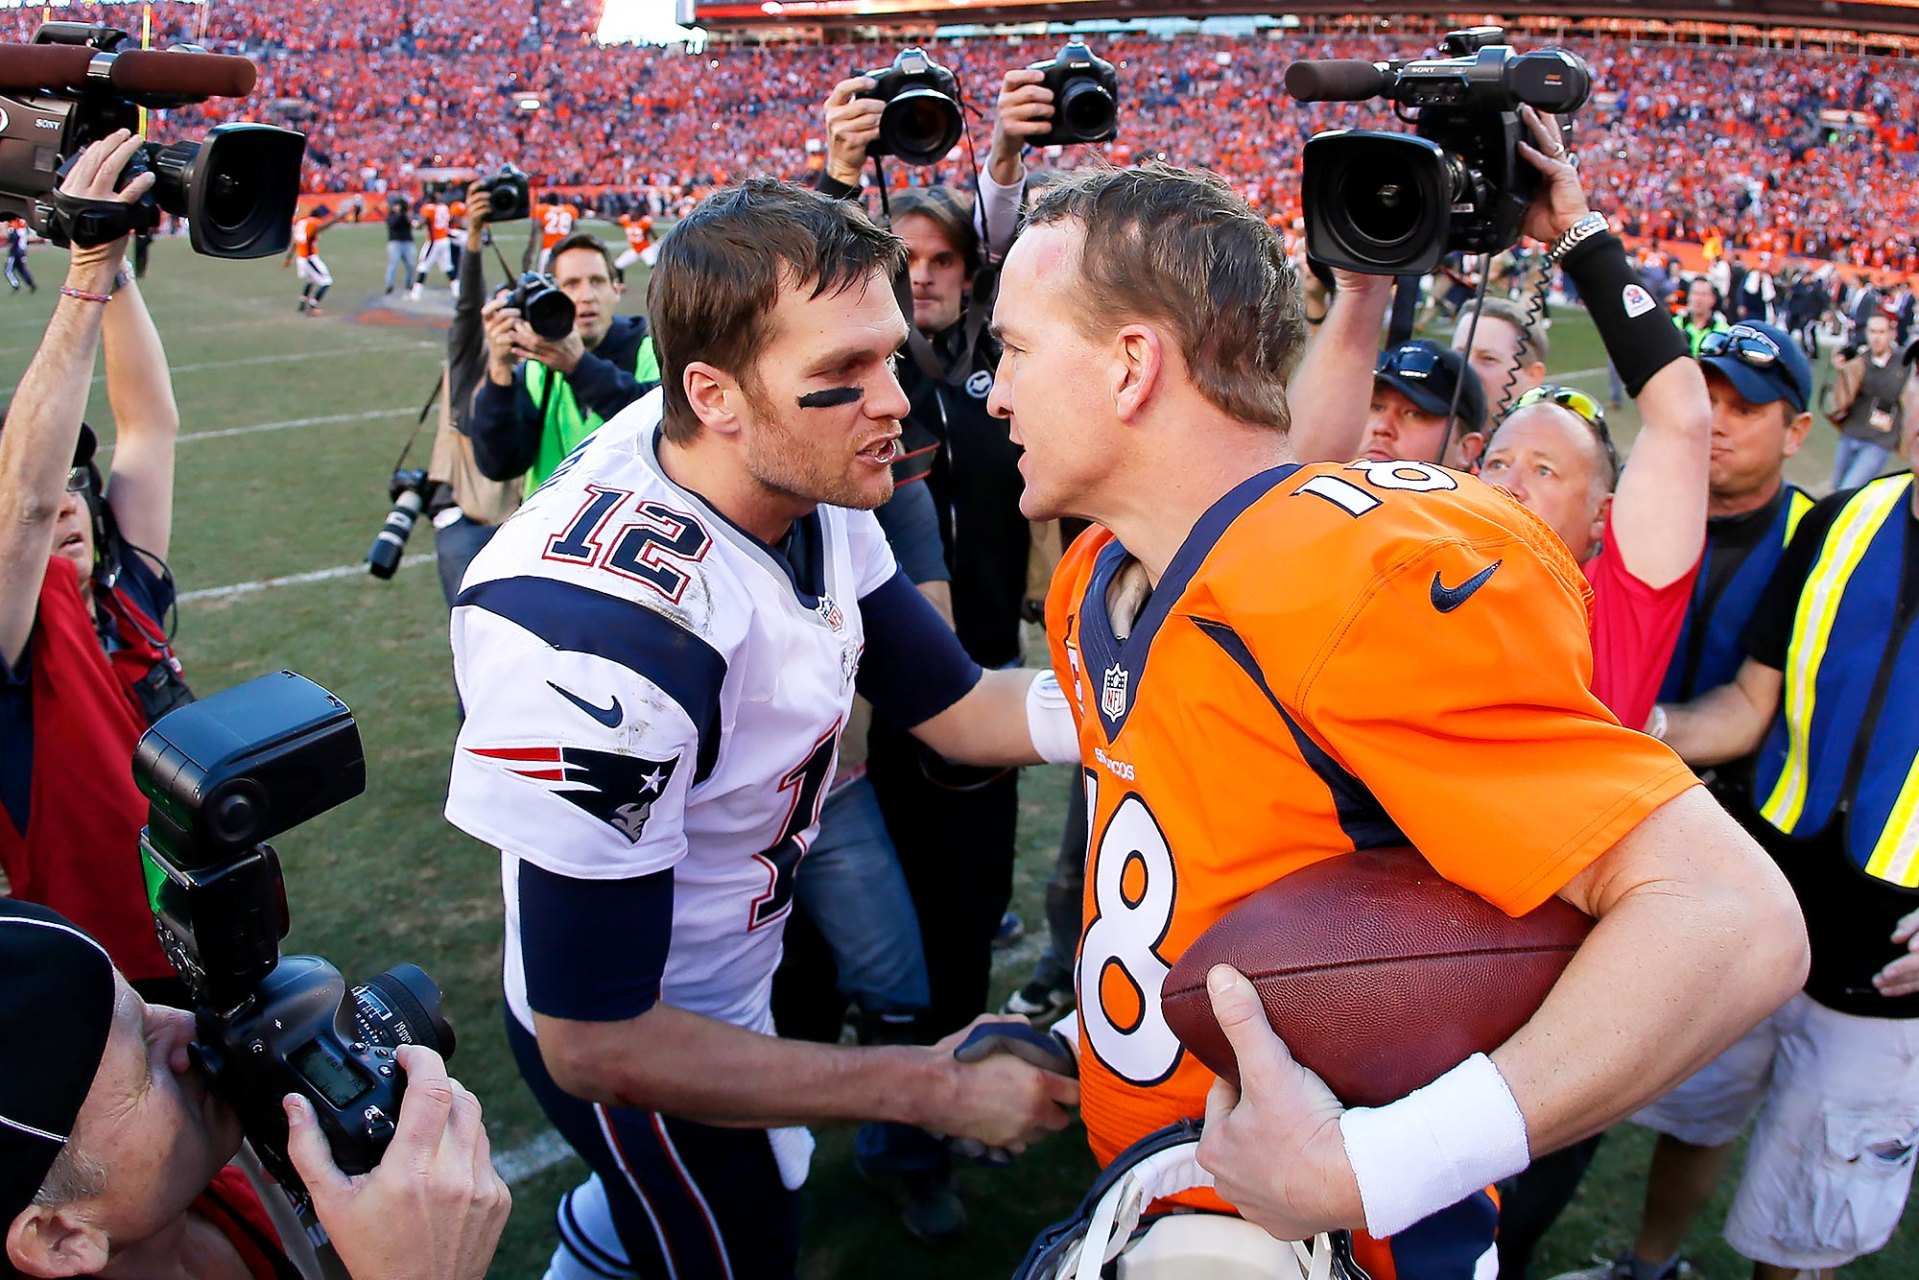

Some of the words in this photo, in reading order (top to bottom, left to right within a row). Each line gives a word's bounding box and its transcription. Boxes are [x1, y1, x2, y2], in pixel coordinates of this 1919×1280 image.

[34, 117, 61, 130] SONY
[1290, 459, 1458, 519] 18
[541, 484, 713, 605] 12
[1106, 688, 1123, 712] NFL
[1080, 766, 1188, 1087] 8
